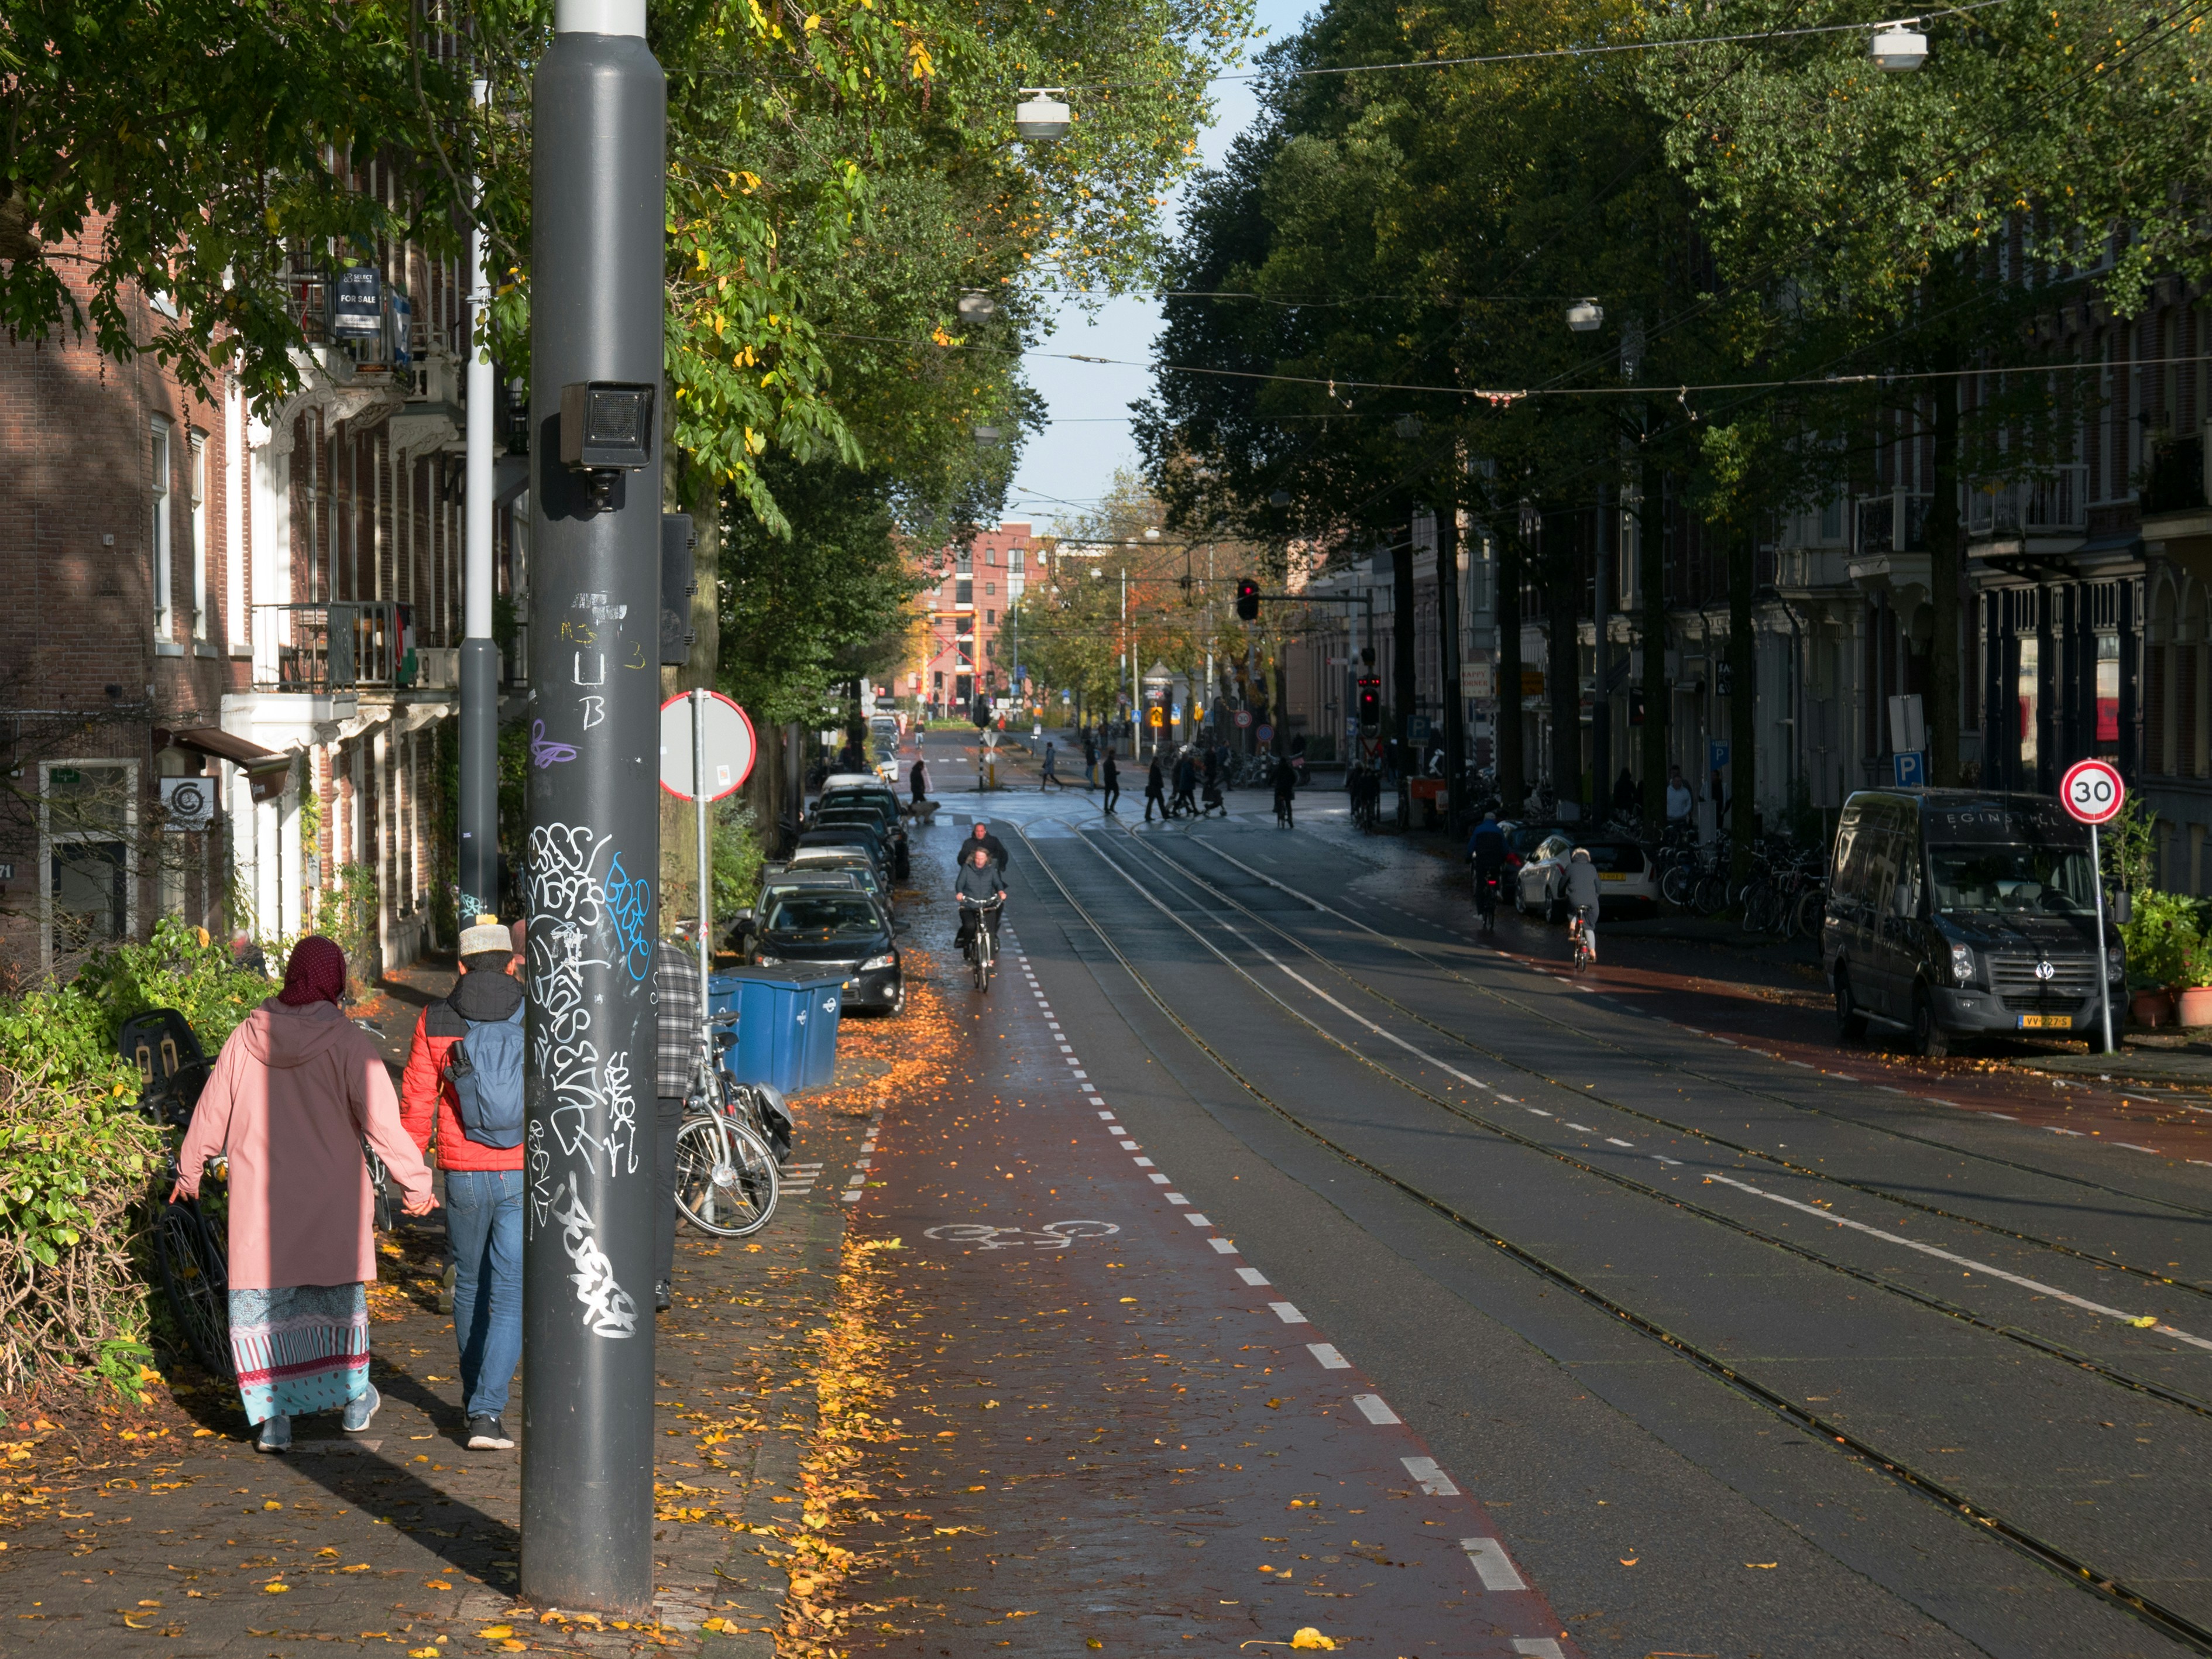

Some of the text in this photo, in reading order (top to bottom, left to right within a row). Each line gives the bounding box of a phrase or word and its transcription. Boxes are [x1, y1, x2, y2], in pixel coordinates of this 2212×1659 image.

[358, 295, 376, 304] SALE
[1413, 719, 1426, 736] P
[1716, 748, 1724, 761] P
[1900, 756, 1916, 782] P
[2074, 781, 2111, 803] 30
[1947, 812, 2059, 827] EGINSTILL
[2027, 1016, 2067, 1026] VV-227-S
